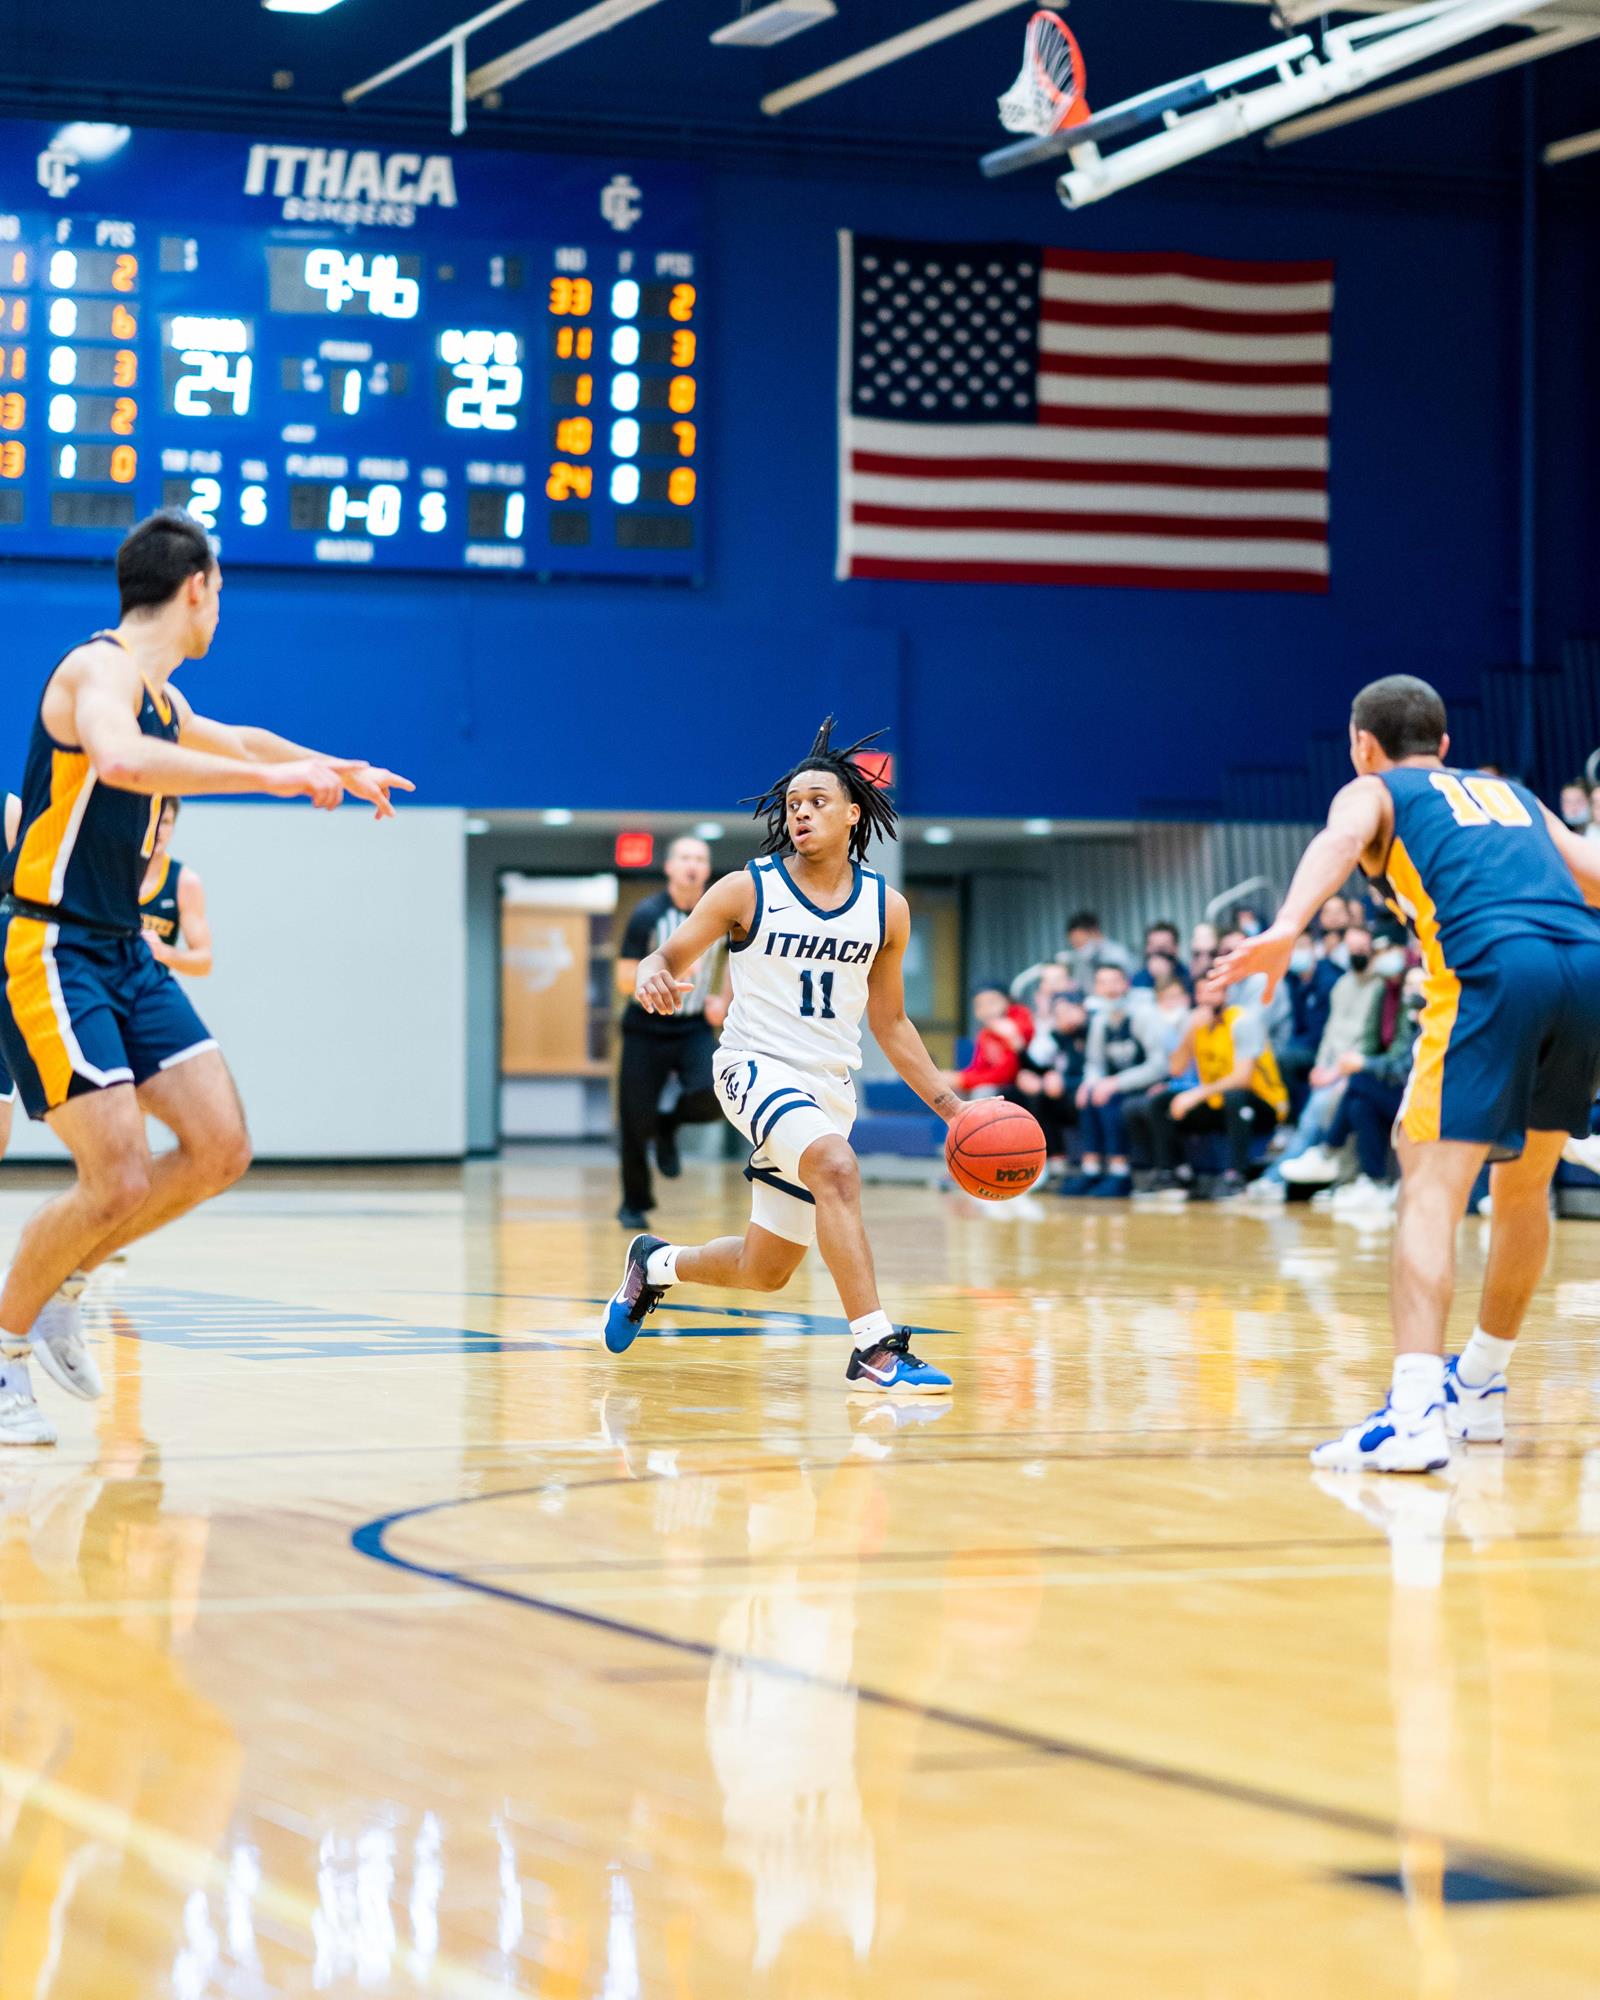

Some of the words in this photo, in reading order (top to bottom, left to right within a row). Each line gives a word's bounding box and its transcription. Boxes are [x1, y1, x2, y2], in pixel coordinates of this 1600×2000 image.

[244, 144, 459, 208] ITHACA
[282, 197, 416, 228] BOMBERS
[111, 253, 139, 293] 2
[548, 276, 593, 317] 33
[668, 282, 697, 323] 2
[111, 303, 138, 340] 6
[556, 325, 594, 362] 11
[670, 328, 697, 369] 3
[113, 349, 138, 388] 3
[174, 350, 253, 417] 24
[343, 368, 362, 416] 1
[445, 362, 523, 430] 22
[575, 372, 593, 408] 1
[110, 396, 138, 436] 2
[671, 419, 697, 458] 7
[58, 443, 77, 480] 1
[110, 444, 138, 484] 0
[545, 461, 594, 502] 24
[187, 477, 222, 530] 2
[504, 491, 525, 539] 1
[1428, 771, 1533, 828] 10
[764, 932, 873, 964] ITHACA
[800, 969, 836, 1019] 11
[995, 1165, 1039, 1182] NCAA
